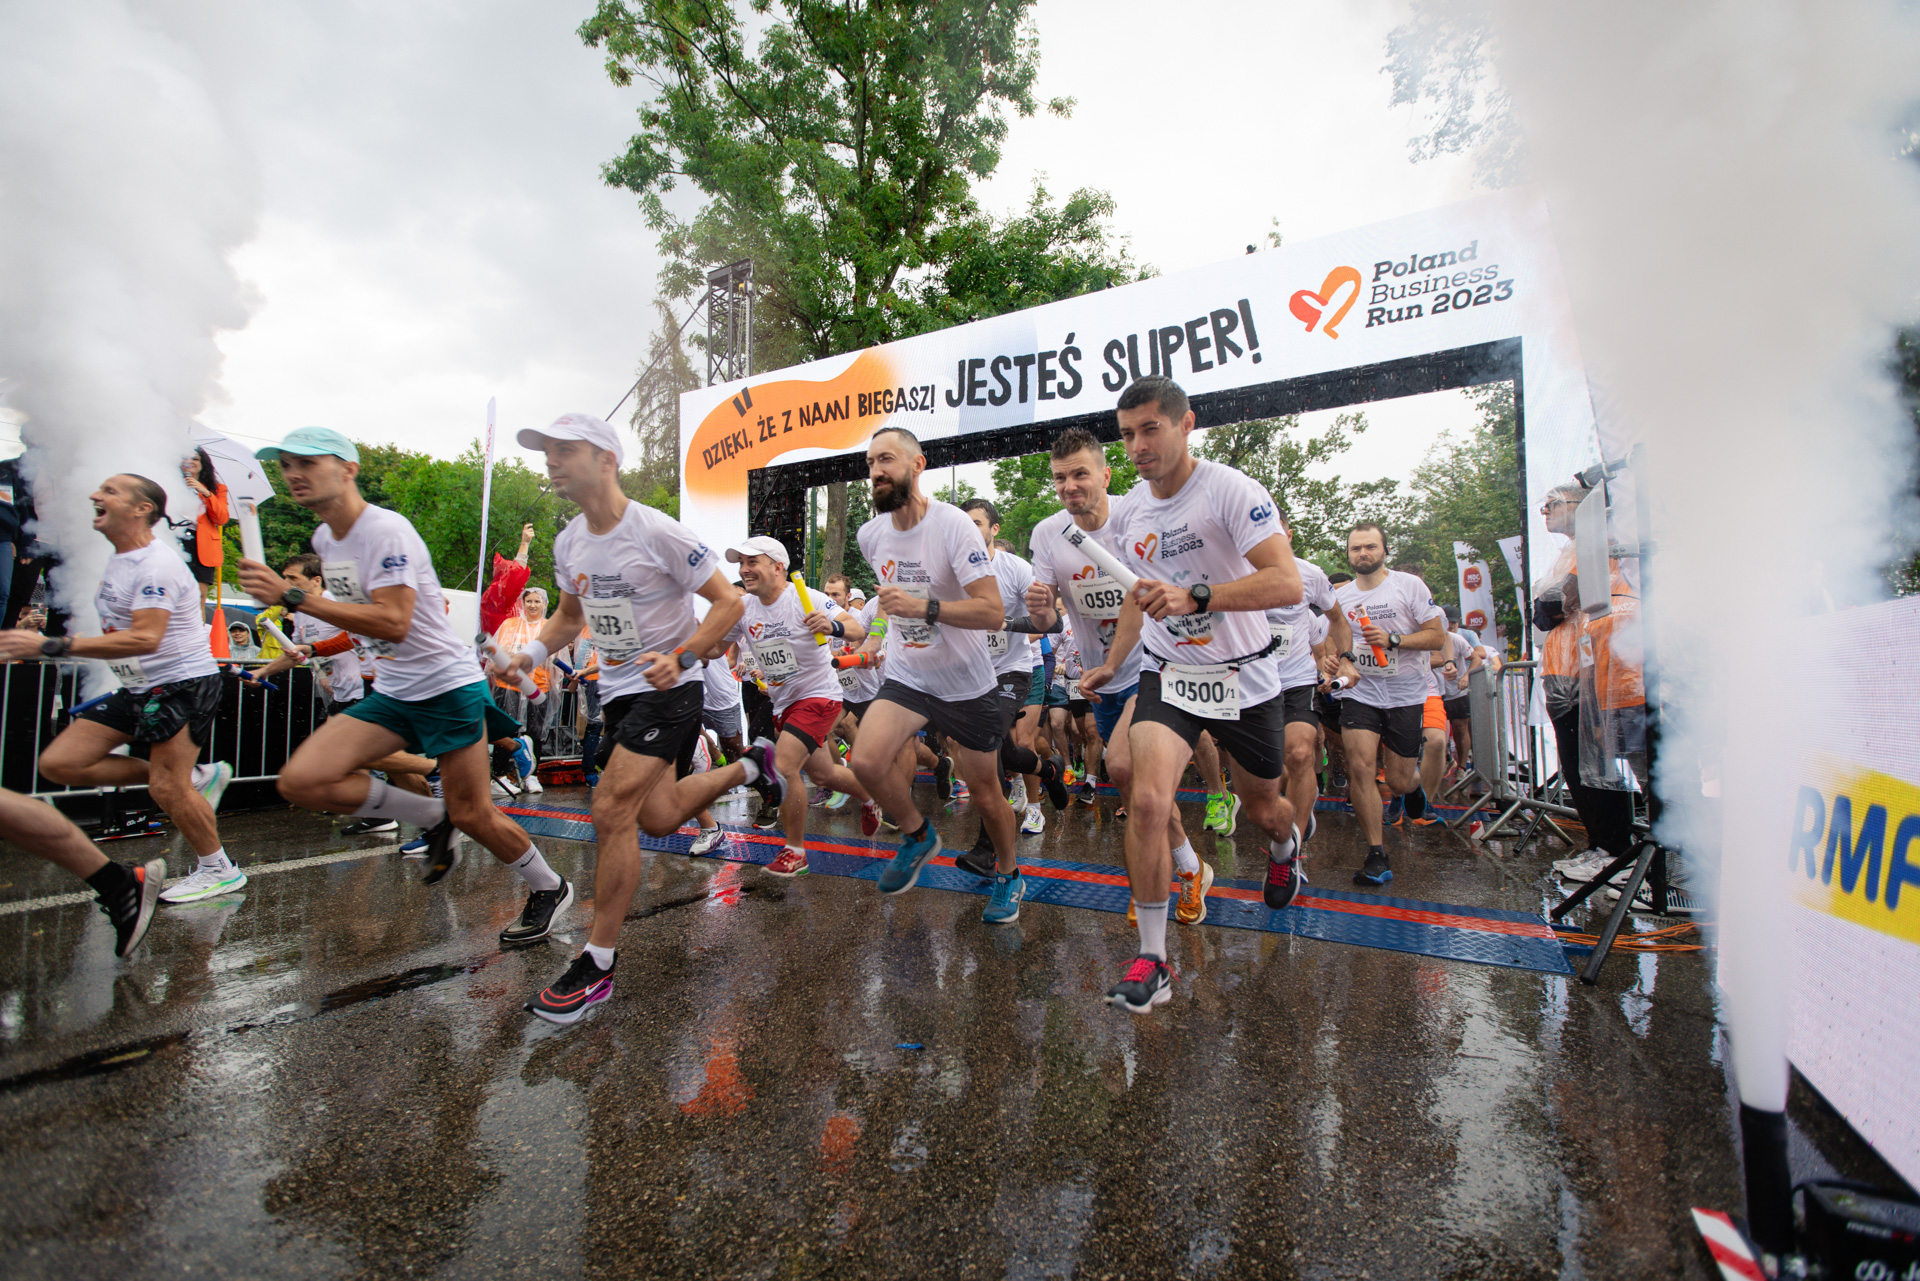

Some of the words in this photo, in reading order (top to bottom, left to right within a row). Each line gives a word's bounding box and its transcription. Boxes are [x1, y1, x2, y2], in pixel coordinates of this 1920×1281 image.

[1372, 239, 1479, 282] Poland
[1365, 302, 1424, 328] Run
[1431, 278, 1514, 315] 2023
[1369, 264, 1499, 305] Business
[945, 332, 1082, 408] JESTEŚ
[1102, 298, 1262, 393] SUPER!
[702, 429, 753, 470] DZIĘKI,
[757, 415, 777, 443] ŻE
[781, 409, 792, 434] Z
[799, 395, 850, 428] NAMI
[857, 384, 936, 417] BIEGASZ!
[1161, 523, 1188, 540] Poland
[1250, 501, 1272, 522] GL
[1161, 549, 1178, 559] Run
[1178, 539, 1204, 554] 2023
[1085, 589, 1124, 609] 0593
